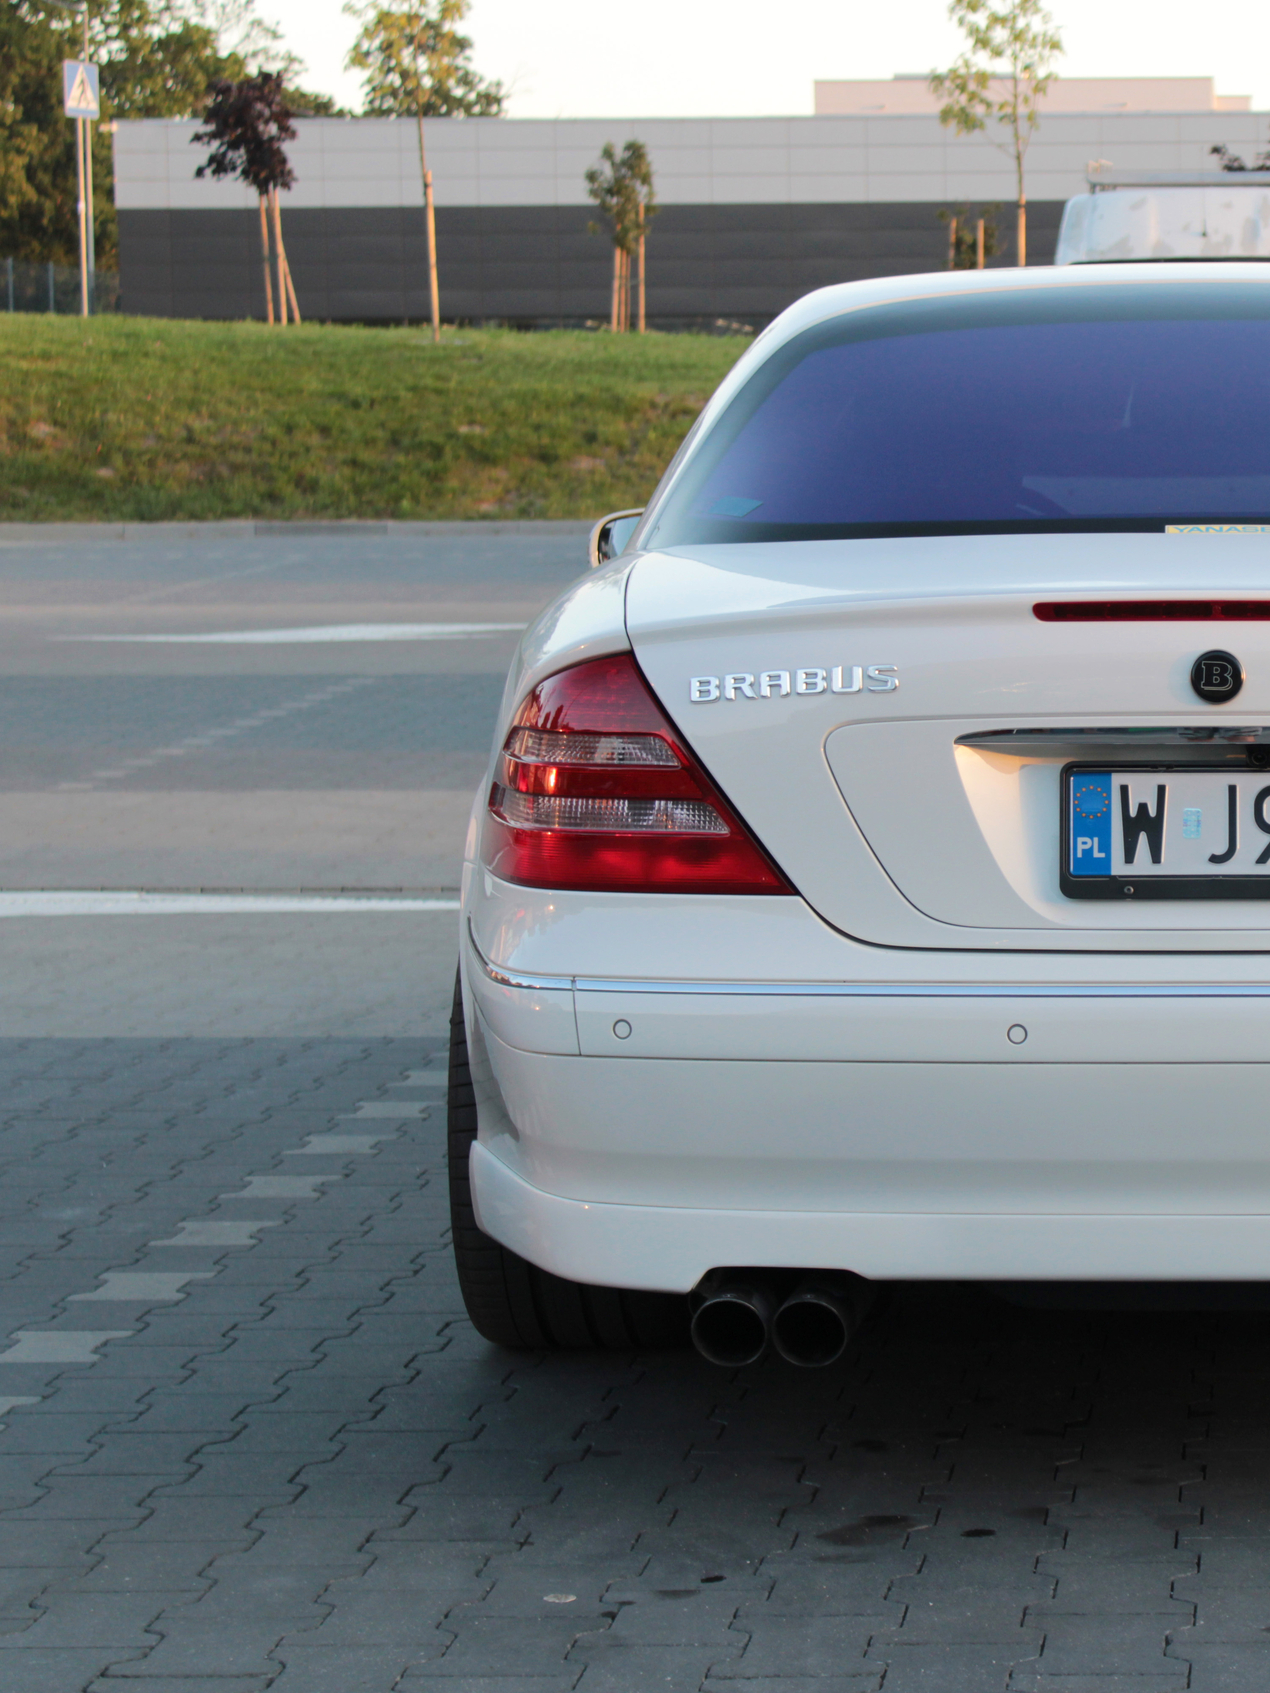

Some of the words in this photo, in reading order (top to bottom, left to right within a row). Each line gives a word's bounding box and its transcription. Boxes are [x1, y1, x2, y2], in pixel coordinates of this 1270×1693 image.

[689, 664, 900, 703] BRABUS
[1201, 660, 1233, 690] B
[1119, 784, 1168, 864] W
[1076, 836, 1107, 858] PL
